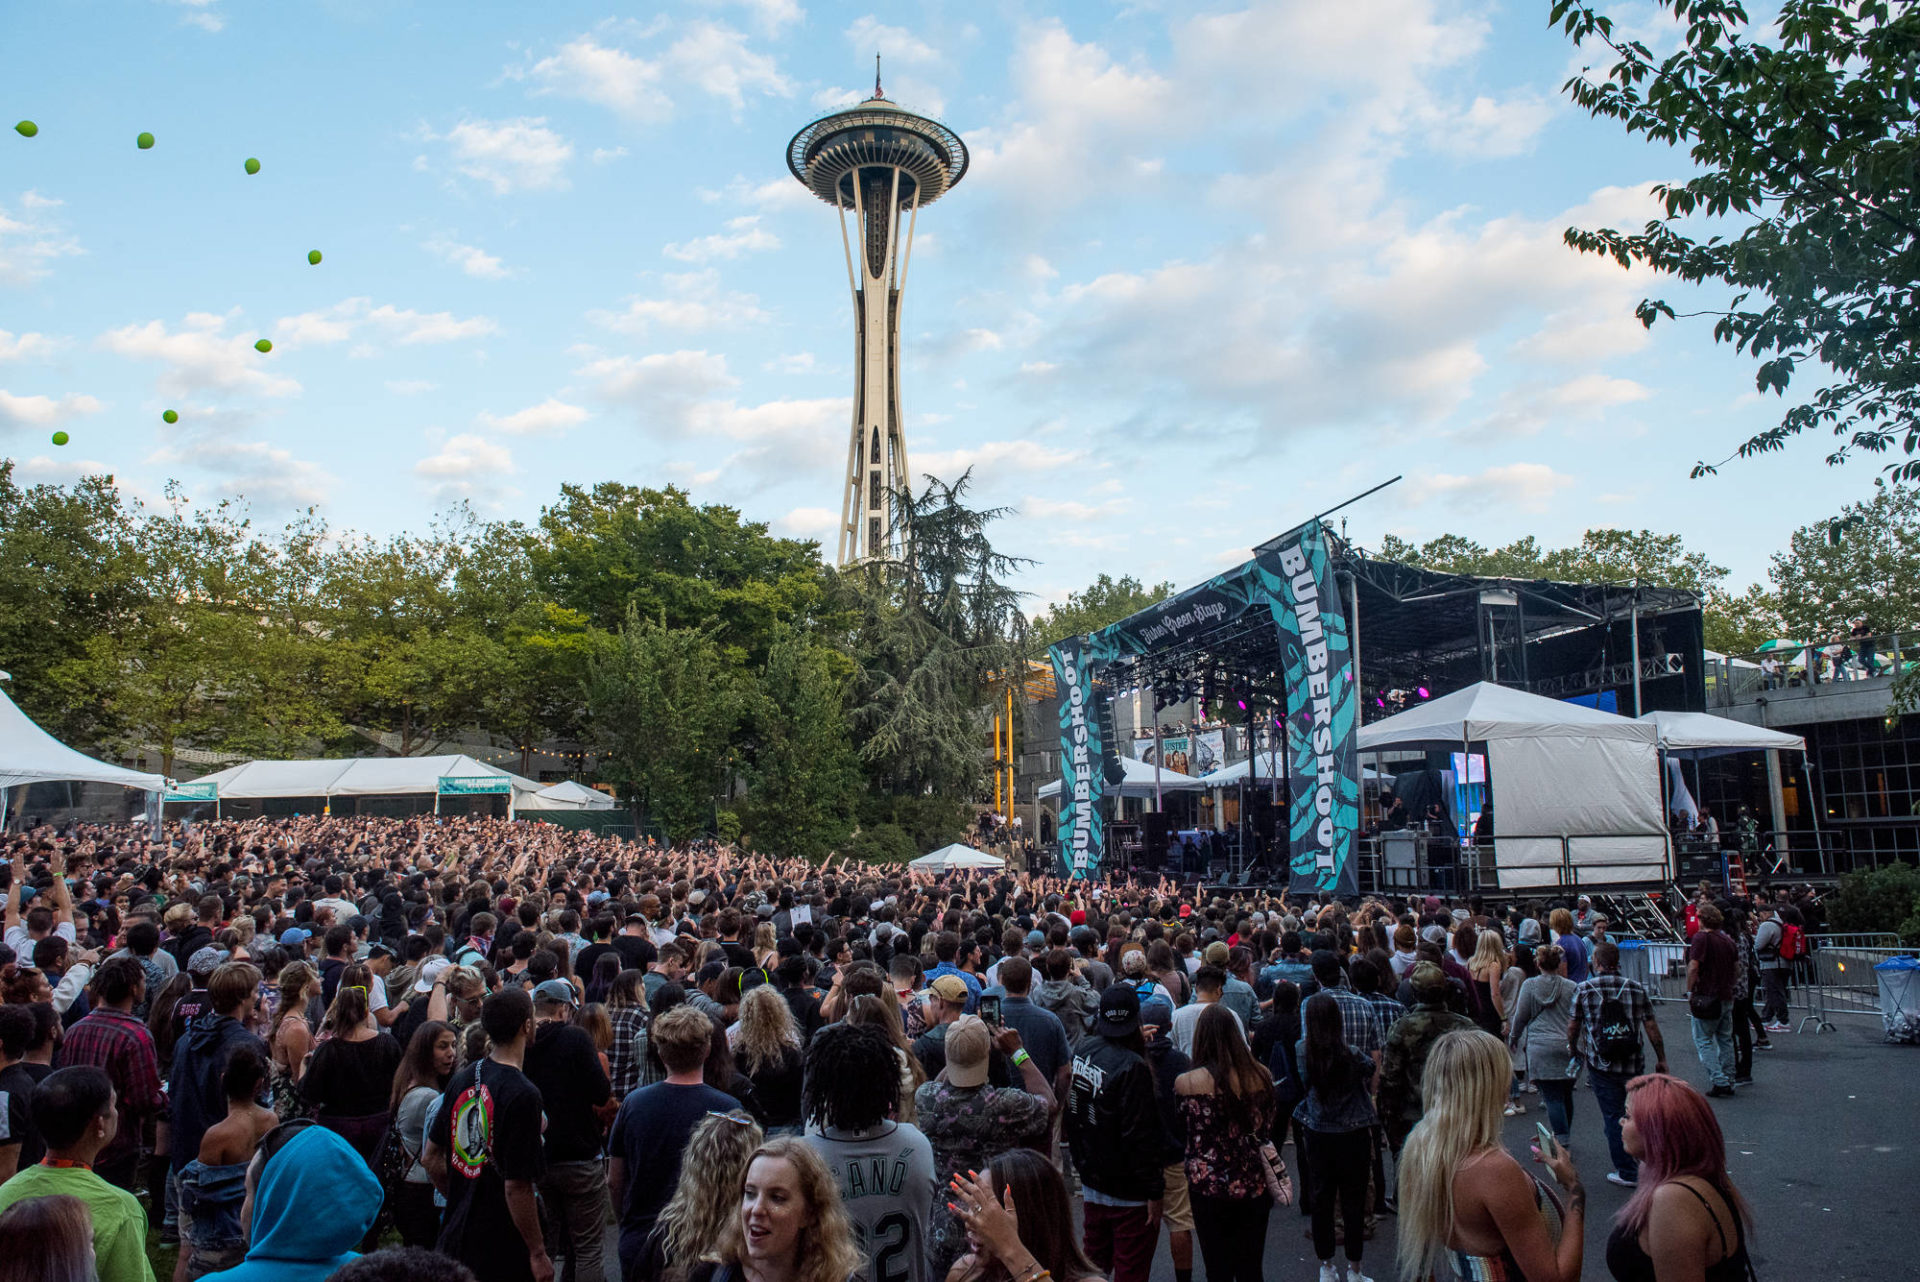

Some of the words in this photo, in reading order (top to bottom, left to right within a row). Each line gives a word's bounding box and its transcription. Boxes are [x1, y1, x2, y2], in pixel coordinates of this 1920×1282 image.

[1161, 615, 1195, 637] Green
[1192, 601, 1227, 625] Stage
[1061, 650, 1092, 869] BUMBERSHOOT
[1164, 740, 1188, 751] JUSTICE
[1279, 542, 1336, 876] BUMBERSHOOT
